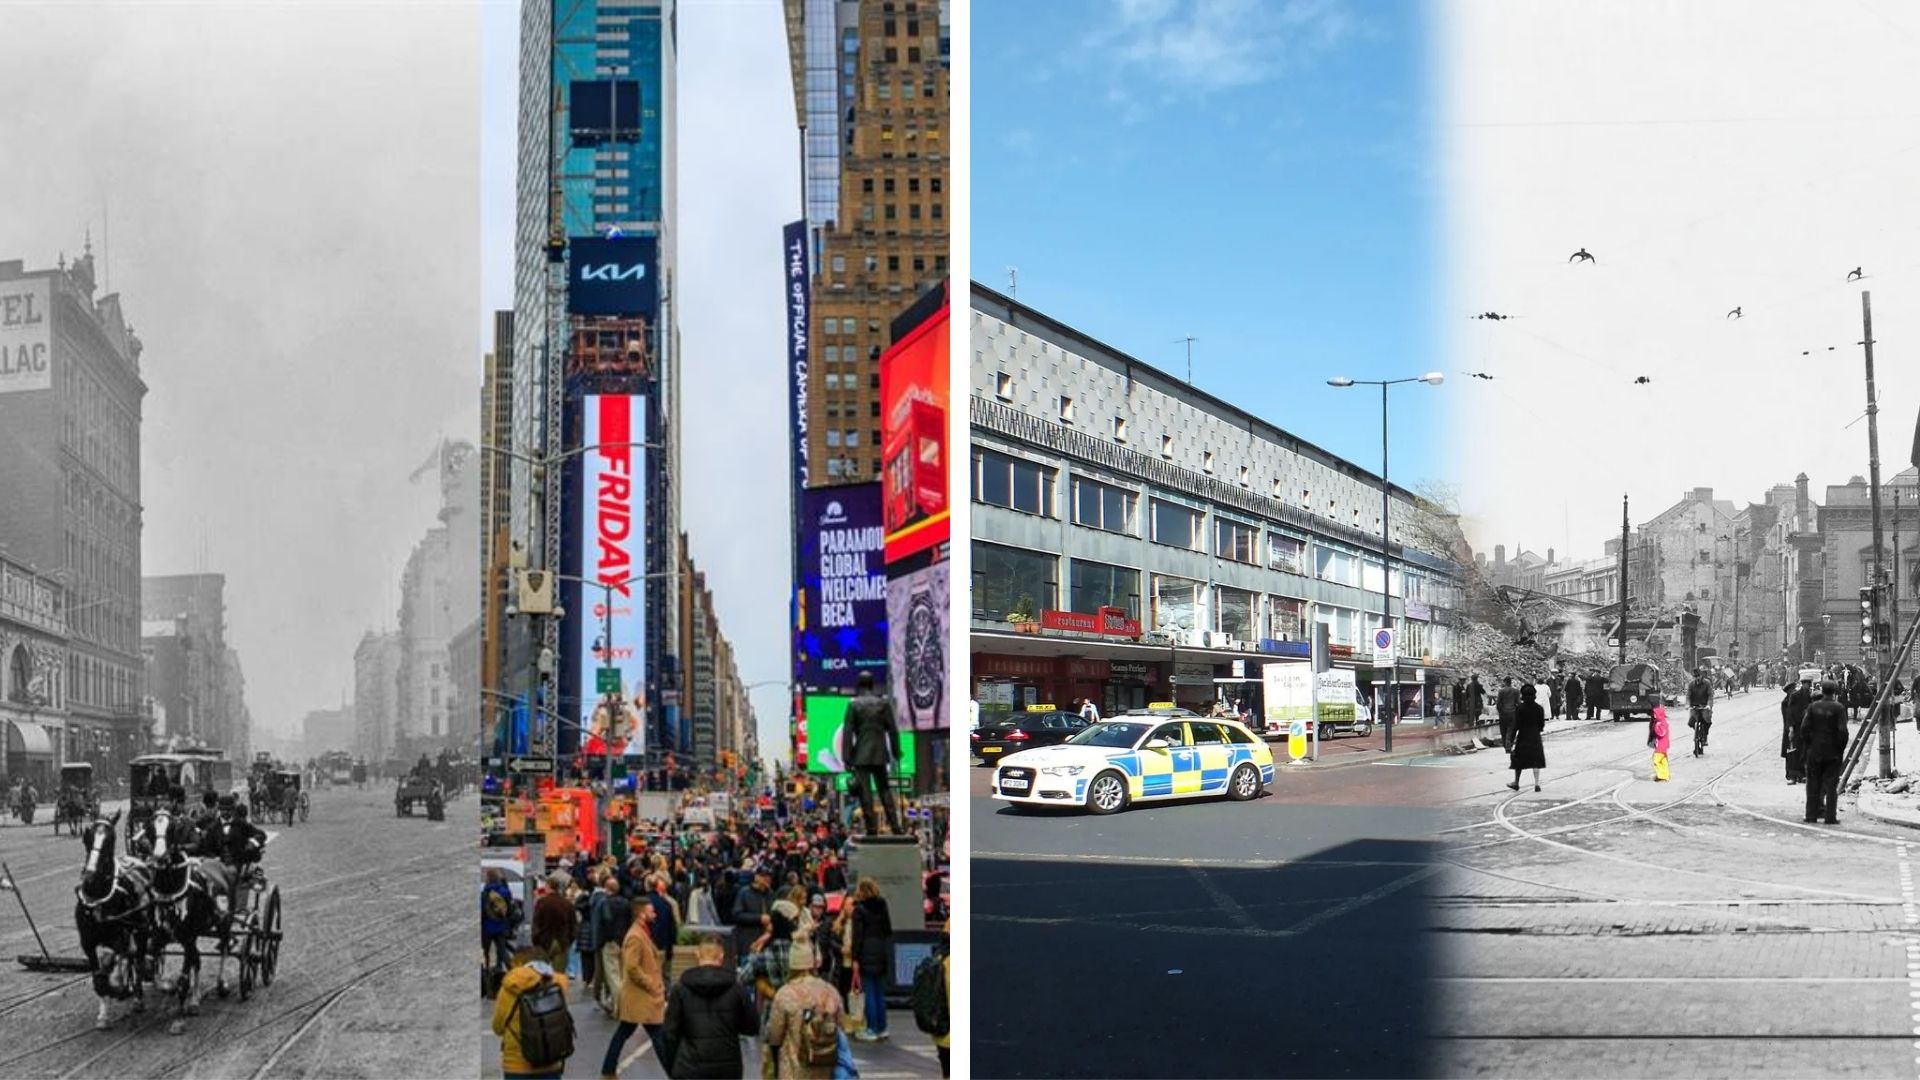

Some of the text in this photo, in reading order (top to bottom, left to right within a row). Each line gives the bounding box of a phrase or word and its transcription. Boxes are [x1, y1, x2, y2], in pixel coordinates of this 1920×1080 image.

[581, 263, 645, 281] KIA
[790, 238, 803, 278] THE
[0, 292, 43, 326] EL
[793, 281, 807, 356] OFFICIAL
[0, 342, 47, 375] LAC
[796, 361, 809, 432] CAMERA
[597, 446, 631, 598] FRIDAY
[821, 552, 868, 578] GLOBAL
[821, 601, 856, 627] BECA
